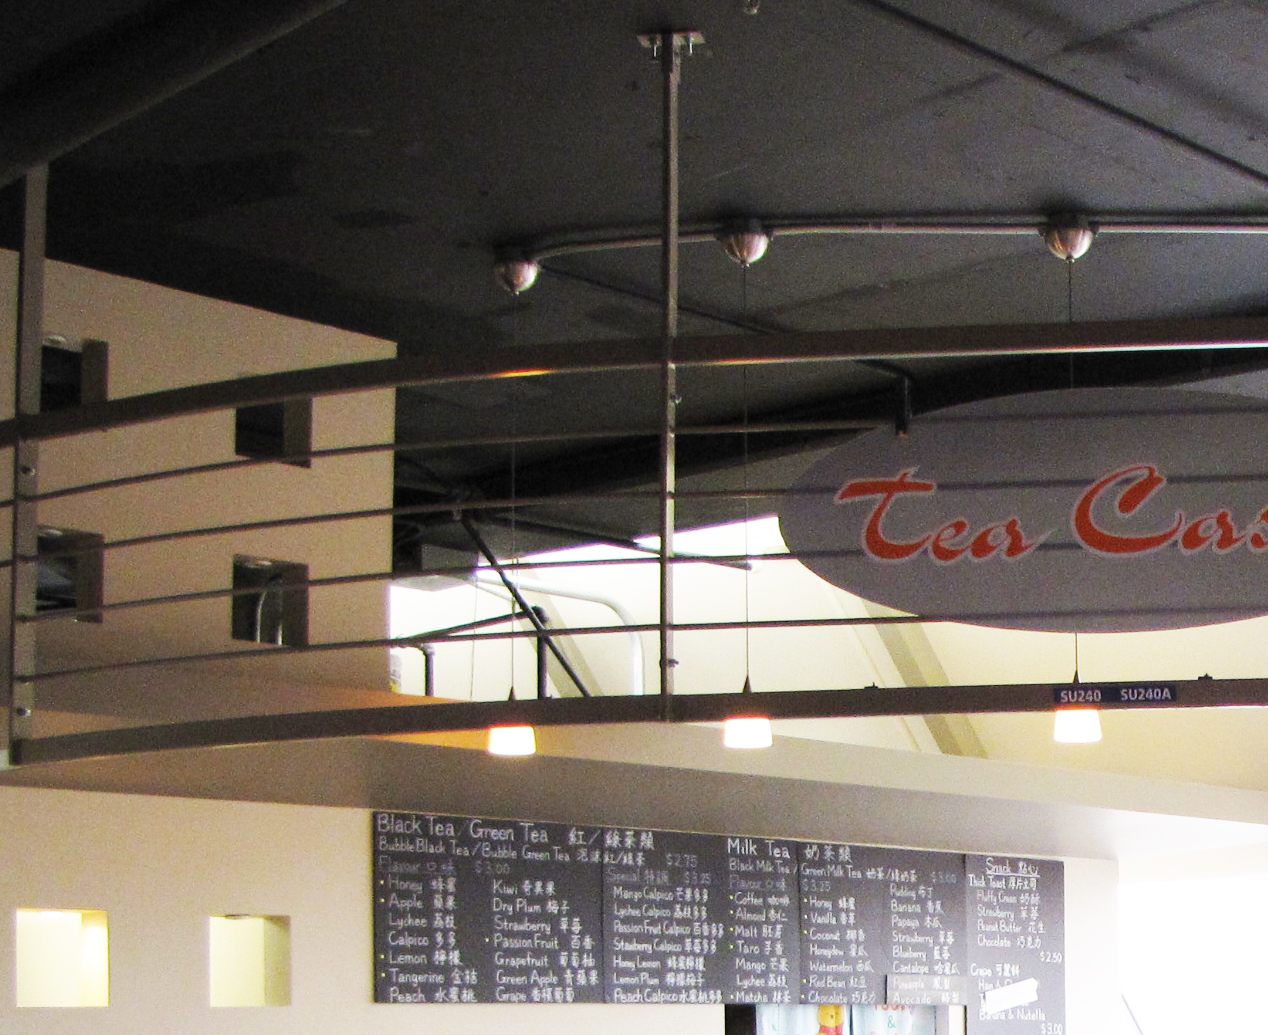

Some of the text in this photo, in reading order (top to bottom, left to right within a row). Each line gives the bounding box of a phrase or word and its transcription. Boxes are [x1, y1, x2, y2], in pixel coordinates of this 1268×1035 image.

[836, 464, 1050, 565] Tea
[1060, 688, 1171, 703] SU240 SU240A
[377, 813, 423, 836] Black
[519, 822, 549, 844] Tea
[379, 836, 415, 854] Bubble
[416, 837, 447, 854] Black
[522, 844, 551, 861] Green
[553, 846, 570, 862] Tea
[727, 838, 758, 856] Milk
[765, 840, 790, 859] Tea
[729, 858, 754, 872] Black
[756, 859, 775, 872] Milk
[801, 862, 825, 876] Green
[827, 864, 844, 877] Milk
[846, 865, 862, 879] Tea
[985, 857, 1011, 874] Snack
[388, 874, 423, 894] Honey
[493, 879, 518, 895] Kiwi
[968, 874, 986, 888] Thick
[988, 875, 1007, 889] Toast
[613, 886, 642, 902] Mango
[643, 886, 674, 902] Calpico
[735, 891, 764, 905] Coffee
[890, 883, 916, 901] Pudding
[389, 893, 423, 911] Apple
[493, 898, 513, 915] Dry
[516, 898, 542, 913] Plum
[809, 895, 832, 911] Honey
[890, 899, 922, 913] Banana
[614, 903, 641, 918] Lychee
[643, 904, 671, 918] Calpico
[735, 907, 766, 922] Almond
[810, 911, 837, 925] Vanilla
[389, 913, 428, 929] Lychee
[494, 915, 551, 934] Strawberry
[614, 920, 643, 933] Passion
[644, 920, 662, 935] Fruit
[663, 920, 691, 936] Calpico
[891, 914, 920, 930] Papaya
[999, 919, 1022, 933] Butter
[735, 924, 758, 938] Malt
[809, 927, 840, 941] Coconut
[892, 930, 933, 947] Strawberry
[388, 930, 429, 949] Calpico
[493, 933, 533, 949] Passion
[534, 933, 559, 950] Fruit
[653, 938, 682, 953] Calpico
[735, 940, 760, 954] Taro
[977, 933, 1011, 947] Chocolate
[389, 950, 428, 965] Lemon
[809, 943, 845, 958] Honeydew
[892, 945, 927, 961] Blueberry
[1040, 951, 1063, 964] $2.50
[494, 951, 548, 969] Grapefruit
[614, 955, 636, 971] Honey
[637, 955, 661, 969] Lemon
[735, 957, 766, 974] Mango
[809, 960, 854, 973] Watermelon
[389, 967, 445, 986] Tangerine
[496, 969, 527, 985] Green
[530, 969, 559, 987] Apple
[970, 962, 993, 978] Crepe
[614, 972, 640, 985] Lemon
[640, 972, 660, 985] Plum
[736, 974, 766, 989] Lychee
[808, 974, 826, 988] Red
[826, 975, 846, 988] Bean
[390, 986, 426, 1003] Peach
[496, 986, 527, 1003] Grape
[614, 987, 644, 1003] Peach
[644, 988, 678, 1004] Calpico
[736, 990, 768, 1003] Matcha
[808, 990, 848, 1004] Chocolate
[893, 991, 932, 1005] Avocado
[1016, 1007, 1046, 1021] Nutella
[1041, 1022, 1063, 1035] $3.00
